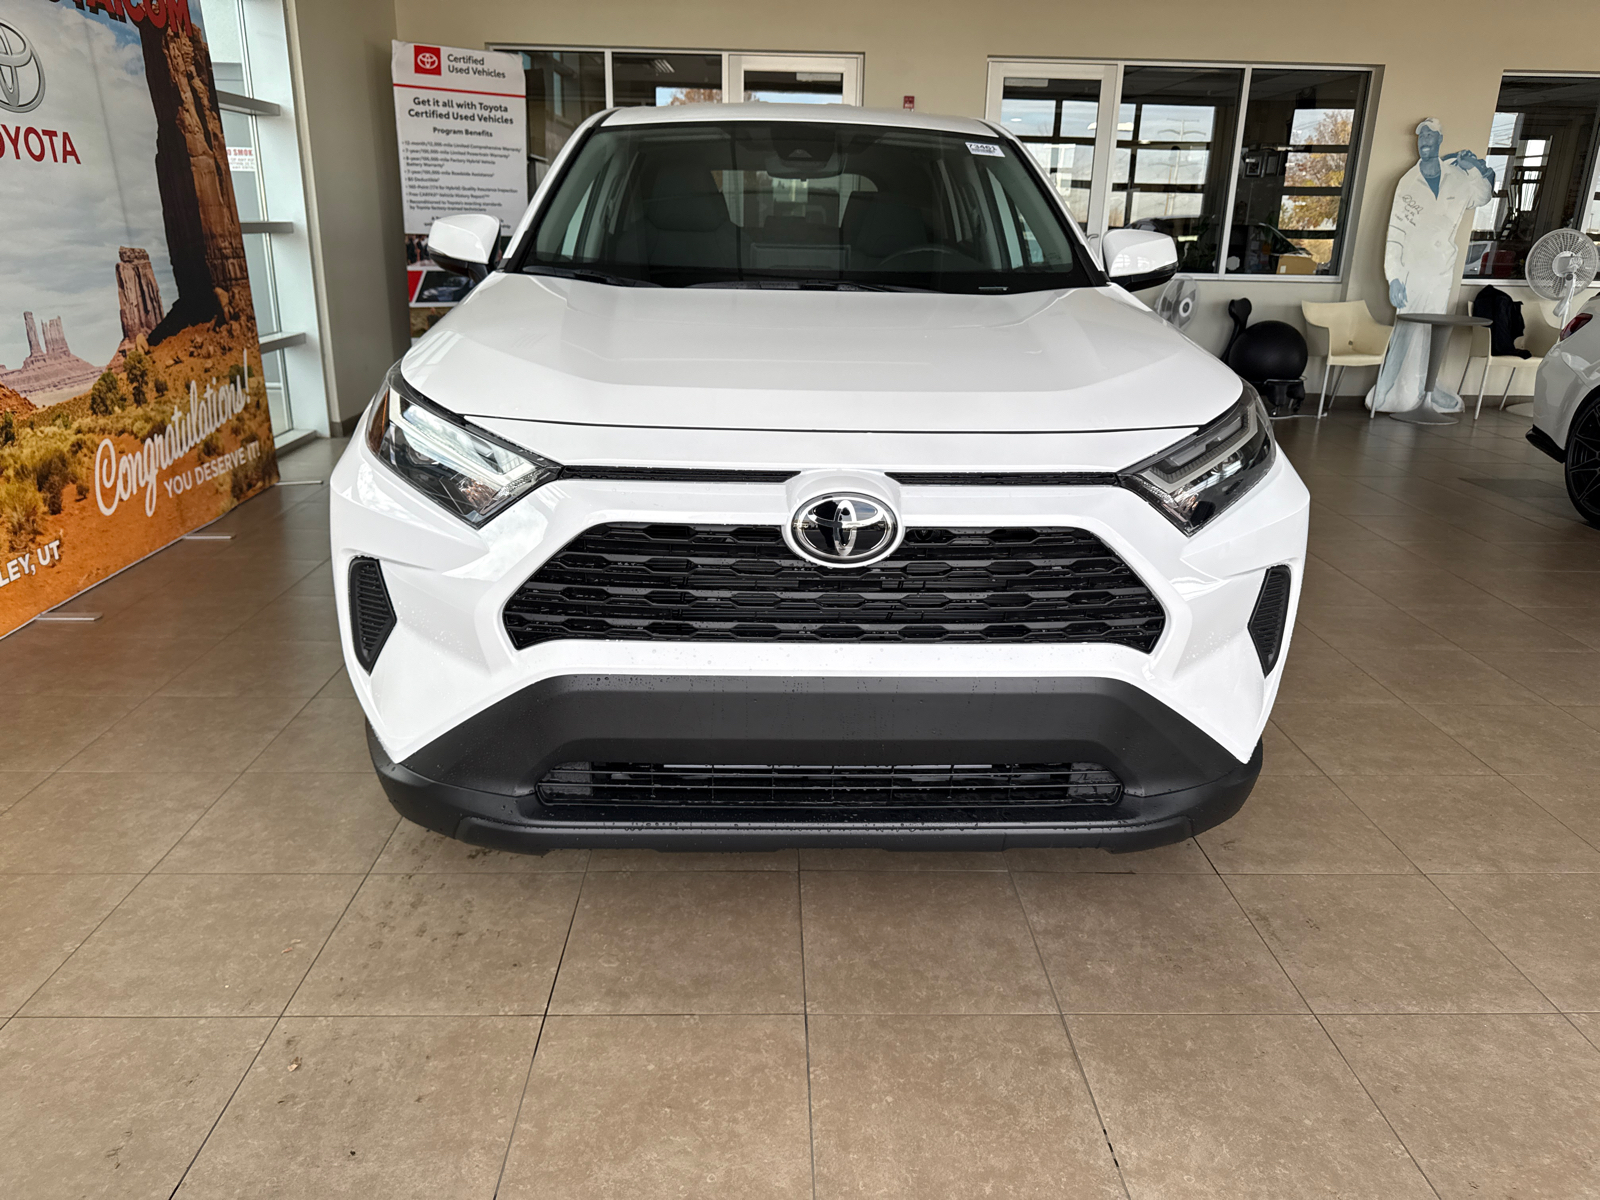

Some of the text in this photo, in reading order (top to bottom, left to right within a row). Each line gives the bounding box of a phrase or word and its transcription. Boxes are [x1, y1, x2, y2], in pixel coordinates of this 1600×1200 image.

[447, 53, 485, 65] Certified
[448, 64, 506, 79] Used Vehicles
[413, 97, 508, 113] Get it all with Toyota
[408, 109, 514, 125] Certified Used Vehicles
[433, 127, 493, 138] Program Benefits
[0, 124, 82, 165] YOTA
[94, 348, 250, 517] Congratulations!
[163, 440, 260, 498] YOU DESERVE IT!
[37, 540, 60, 566] UT
